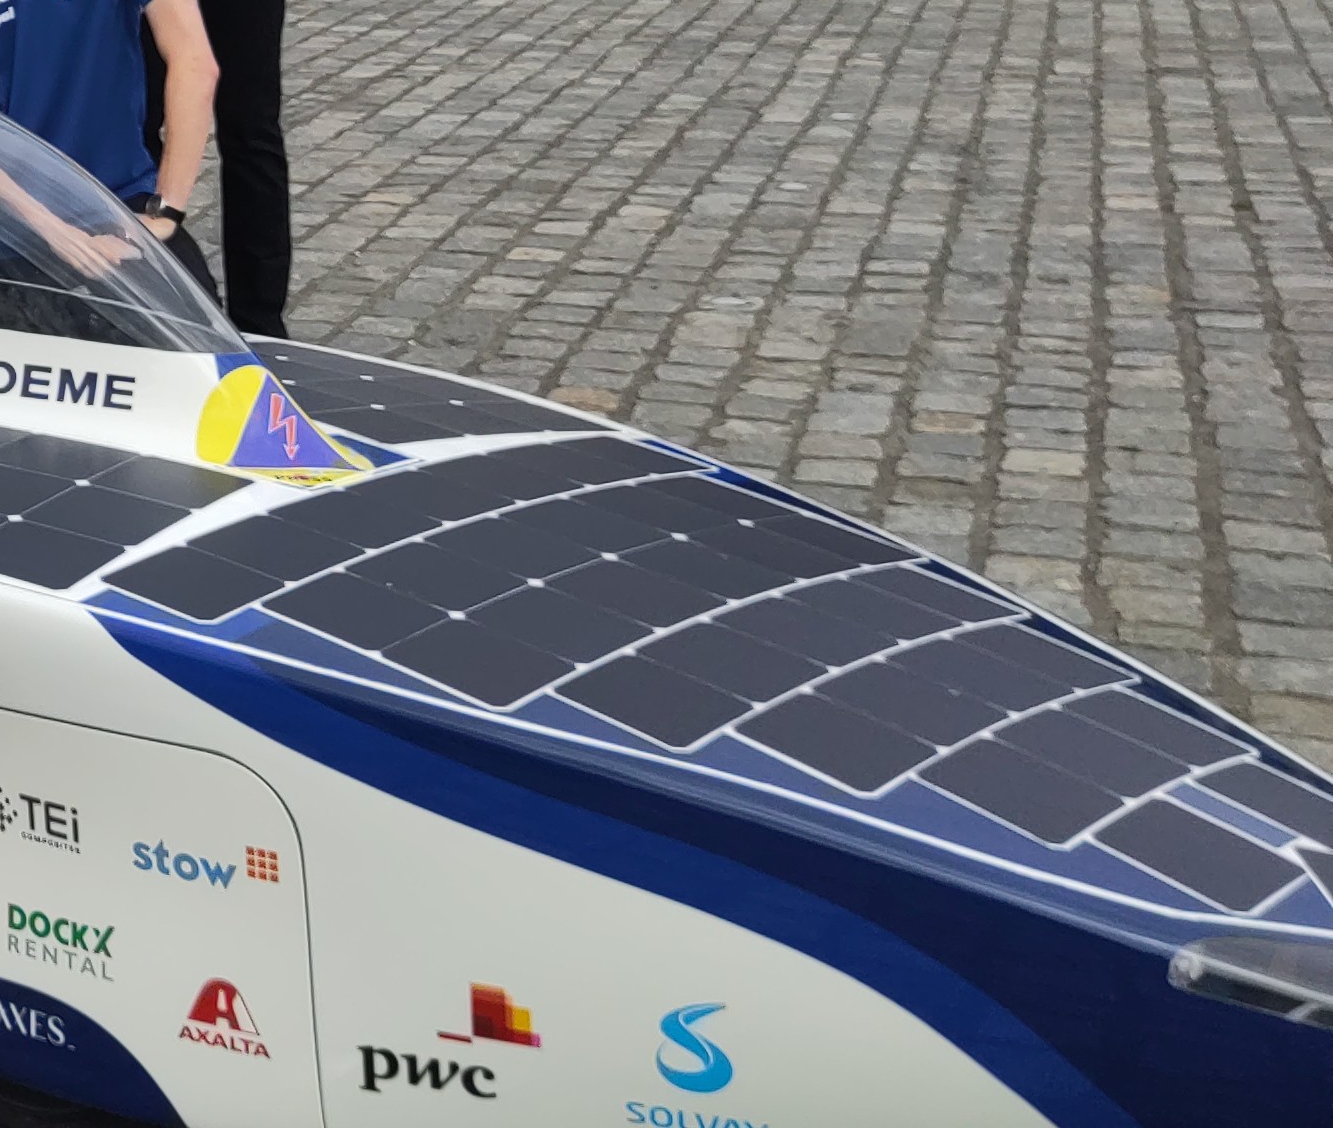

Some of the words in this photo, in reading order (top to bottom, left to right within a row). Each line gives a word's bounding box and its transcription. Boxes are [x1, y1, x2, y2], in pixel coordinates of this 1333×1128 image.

[132, 839, 237, 889] stow
[7, 902, 115, 958] DOCKX
[8, 933, 114, 982] RENTAL
[178, 1025, 272, 1059] AXALTA
[357, 1044, 497, 1099] pwc
